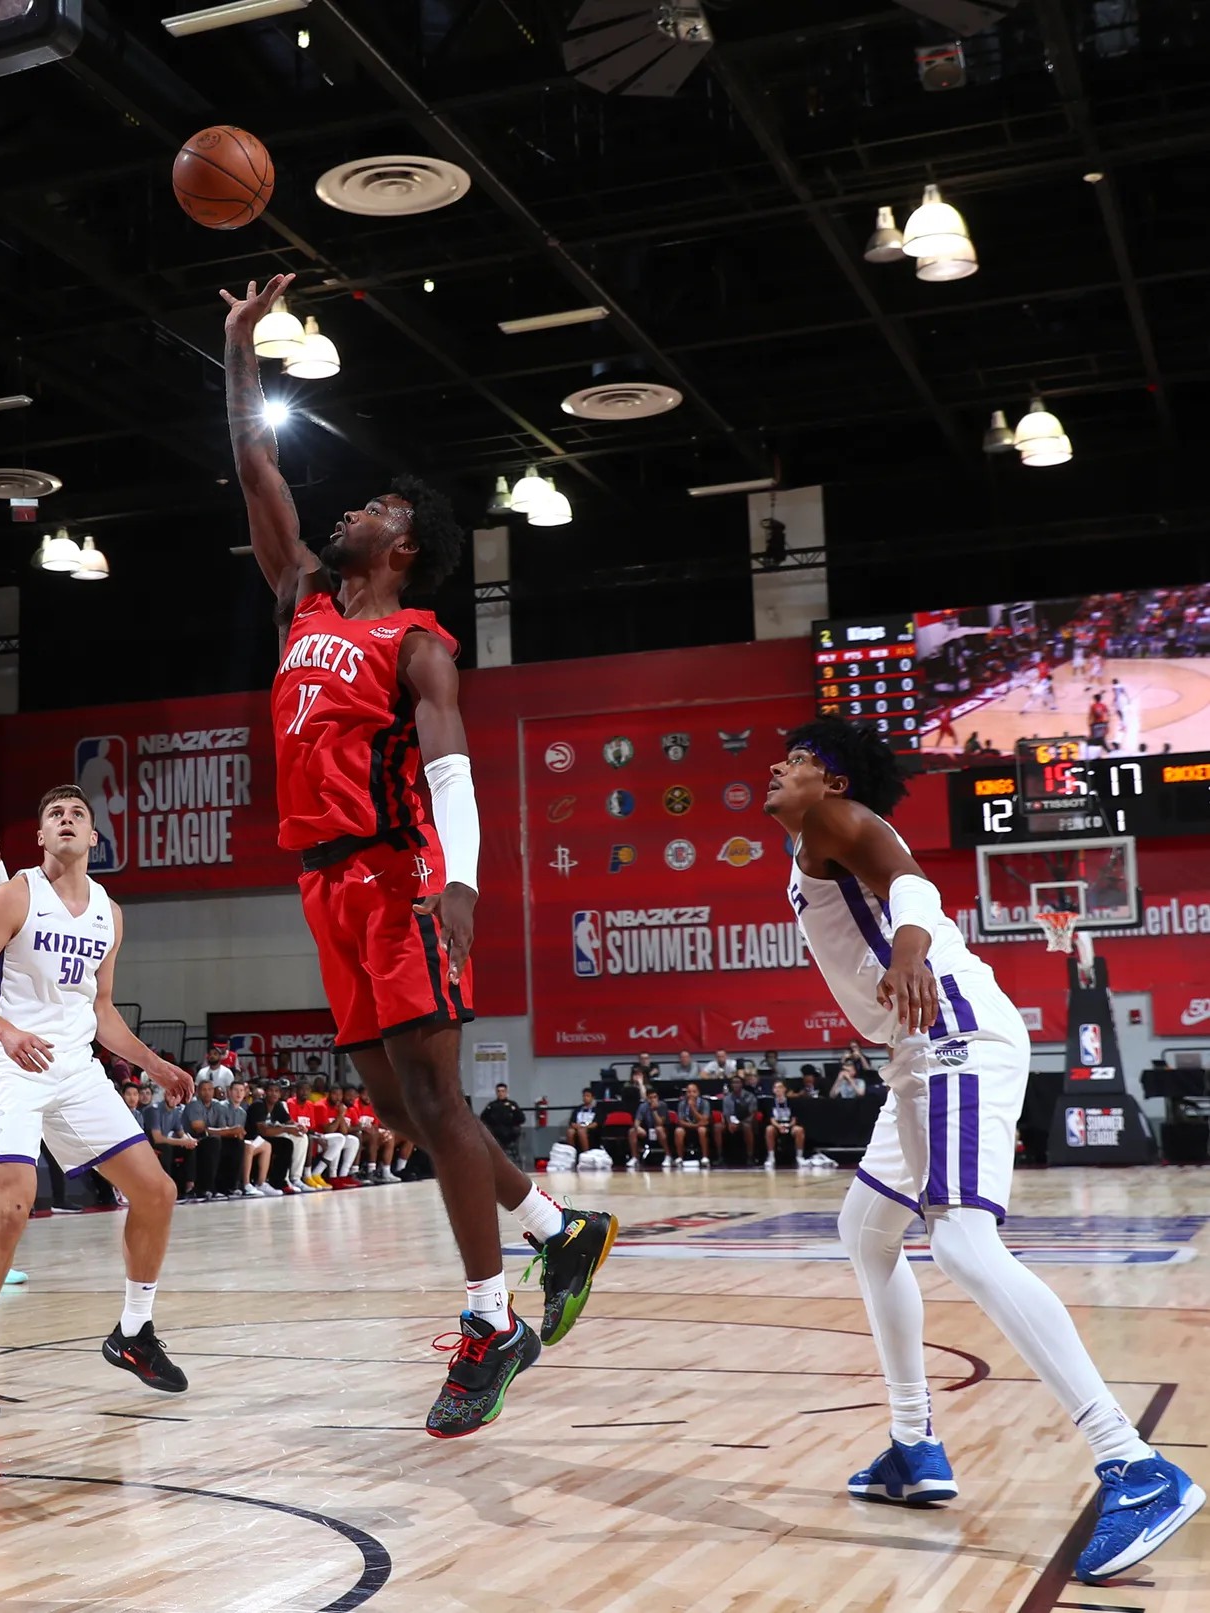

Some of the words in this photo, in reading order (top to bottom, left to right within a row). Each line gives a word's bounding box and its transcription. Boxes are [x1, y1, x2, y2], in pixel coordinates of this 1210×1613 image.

[138, 727, 250, 755] NBA2K23
[138, 754, 251, 813] SUMMER
[983, 799, 1013, 832] 12
[138, 810, 233, 868] LEAGUE
[605, 905, 711, 928] NBA2K23
[33, 931, 107, 960] KINGS
[606, 926, 713, 975] SUMMER
[719, 922, 809, 971] LEAGUE
[58, 957, 85, 985] 50
[556, 1030, 606, 1044] Hennessy
[804, 1018, 847, 1029] ULTRA
